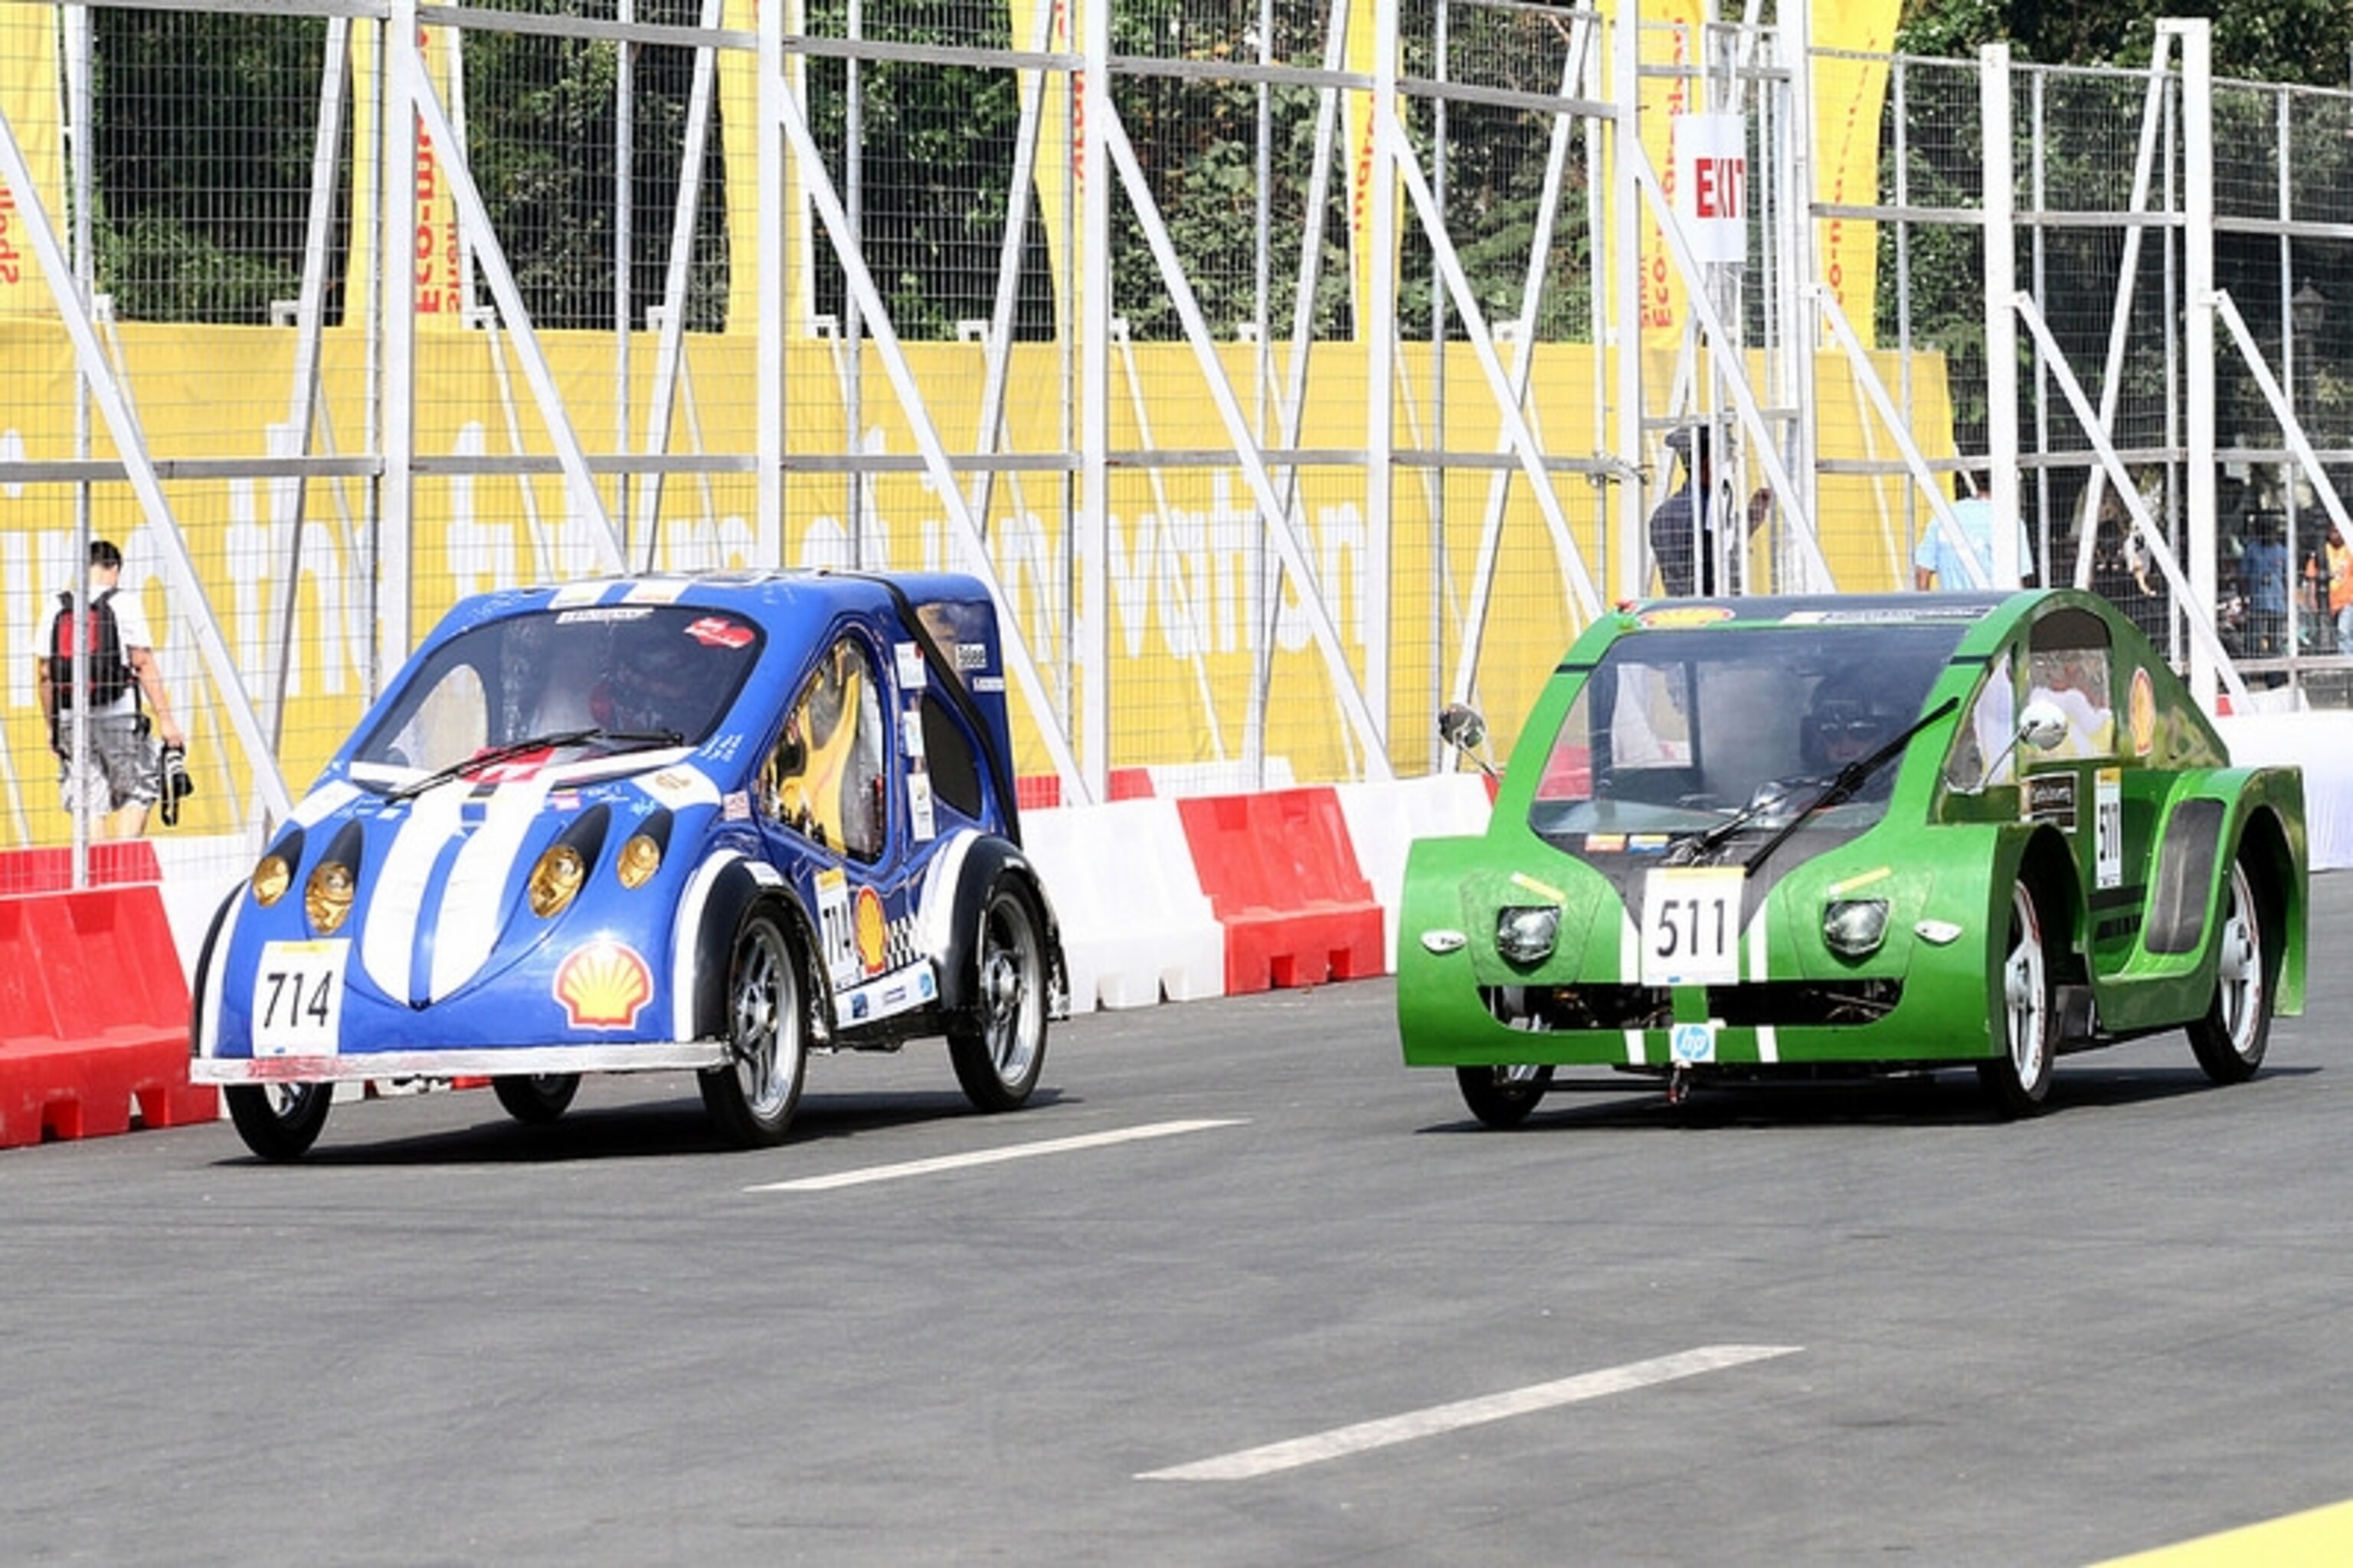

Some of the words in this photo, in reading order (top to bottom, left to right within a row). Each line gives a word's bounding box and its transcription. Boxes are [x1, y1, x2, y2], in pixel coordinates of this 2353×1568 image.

[1695, 157, 1747, 218] EXIT
[1656, 899, 1725, 957] 511
[263, 970, 332, 1029] 714
